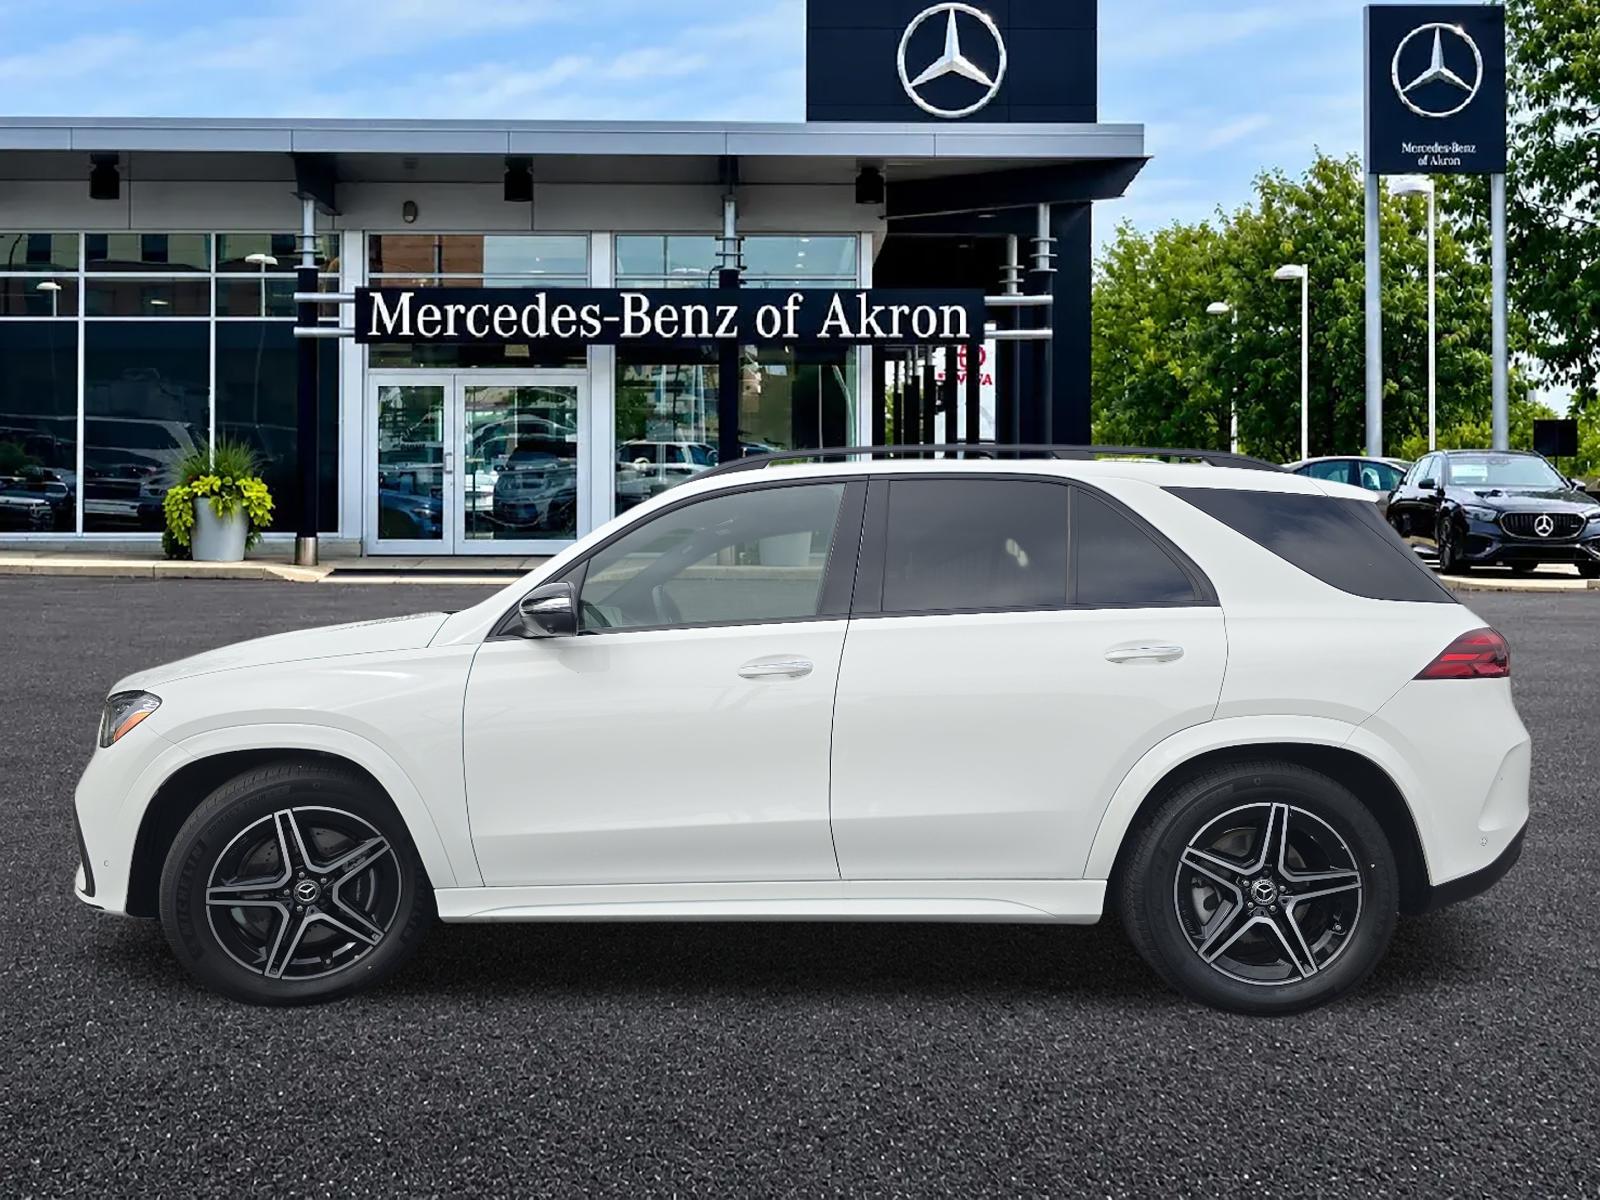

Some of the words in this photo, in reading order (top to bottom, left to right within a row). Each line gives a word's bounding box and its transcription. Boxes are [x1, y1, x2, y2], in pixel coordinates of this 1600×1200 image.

[1401, 142, 1476, 153] Mercedes-Benz
[1417, 154, 1428, 166] of
[1430, 154, 1461, 166] Akron
[367, 291, 738, 339] Mercedes-Benz
[756, 292, 804, 338] of
[817, 292, 971, 338] Akron
